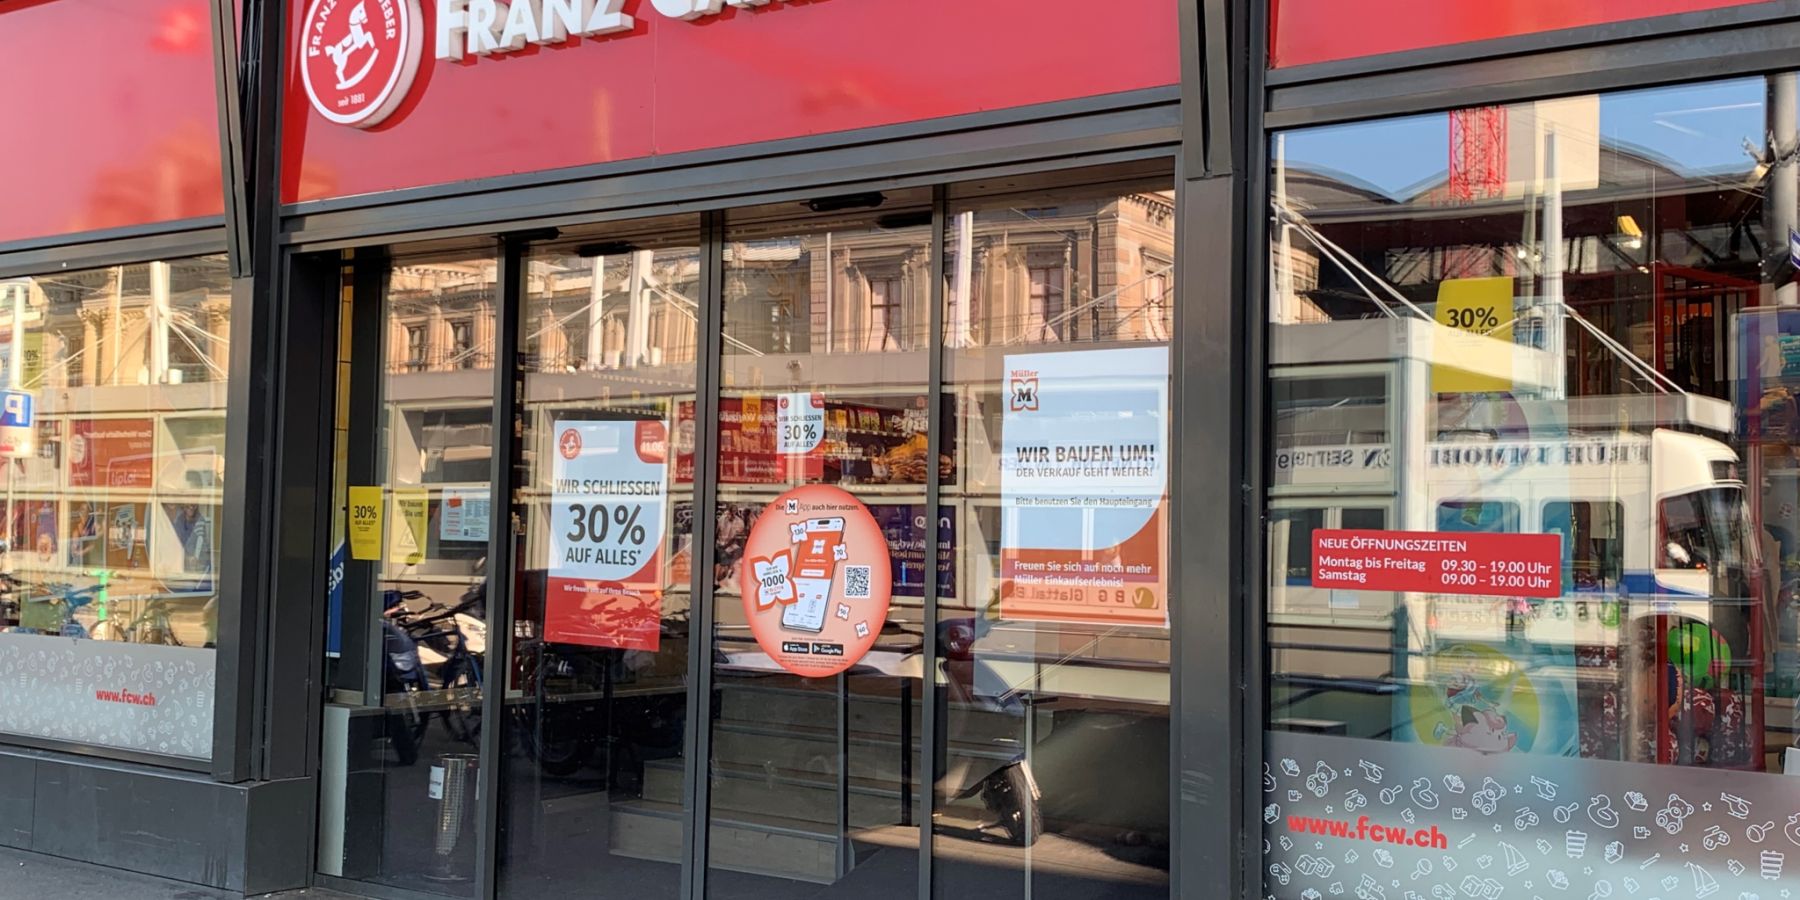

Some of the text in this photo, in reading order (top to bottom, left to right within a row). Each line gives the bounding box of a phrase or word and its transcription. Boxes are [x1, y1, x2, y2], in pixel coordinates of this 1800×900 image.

[435, 0, 634, 60] FRANZ
[1446, 306, 1498, 328] 30%
[1010, 369, 1039, 378] Müller
[784, 423, 817, 440] 30%
[1016, 444, 1154, 463] WIR BAUEN UM!
[1016, 466, 1153, 477] DER VERKAUF GEHT WEITER!
[556, 479, 661, 496] WIR SCHLIESSEN
[1015, 496, 1153, 508] Bitte benutzen Sie den Haupteingang
[353, 505, 377, 519] 30%
[566, 503, 645, 545] 30%
[1319, 536, 1467, 552] NEUE ÖFFNUNGSZEITEN
[565, 547, 592, 563] AUF
[1014, 561, 1152, 574] Freuen Sie sich auf noch mehr
[1319, 555, 1363, 570] Montag
[1365, 556, 1382, 569] bis
[1384, 557, 1426, 572] Freitag
[1441, 559, 1477, 572] 09.30
[1490, 560, 1525, 573] 19.00
[1527, 561, 1552, 574] Uhr
[761, 573, 785, 588] 1000
[1014, 574, 1124, 587] Müller Einkaufserlebnis!
[1319, 568, 1366, 583] Samstag
[1441, 573, 1477, 585] 09.00
[1490, 574, 1525, 587] 19.00
[1527, 575, 1552, 588] Uhr
[563, 584, 573, 592] Wir
[96, 688, 156, 706] www.fcw.ch
[1287, 815, 1447, 849] www.fcw.ch
